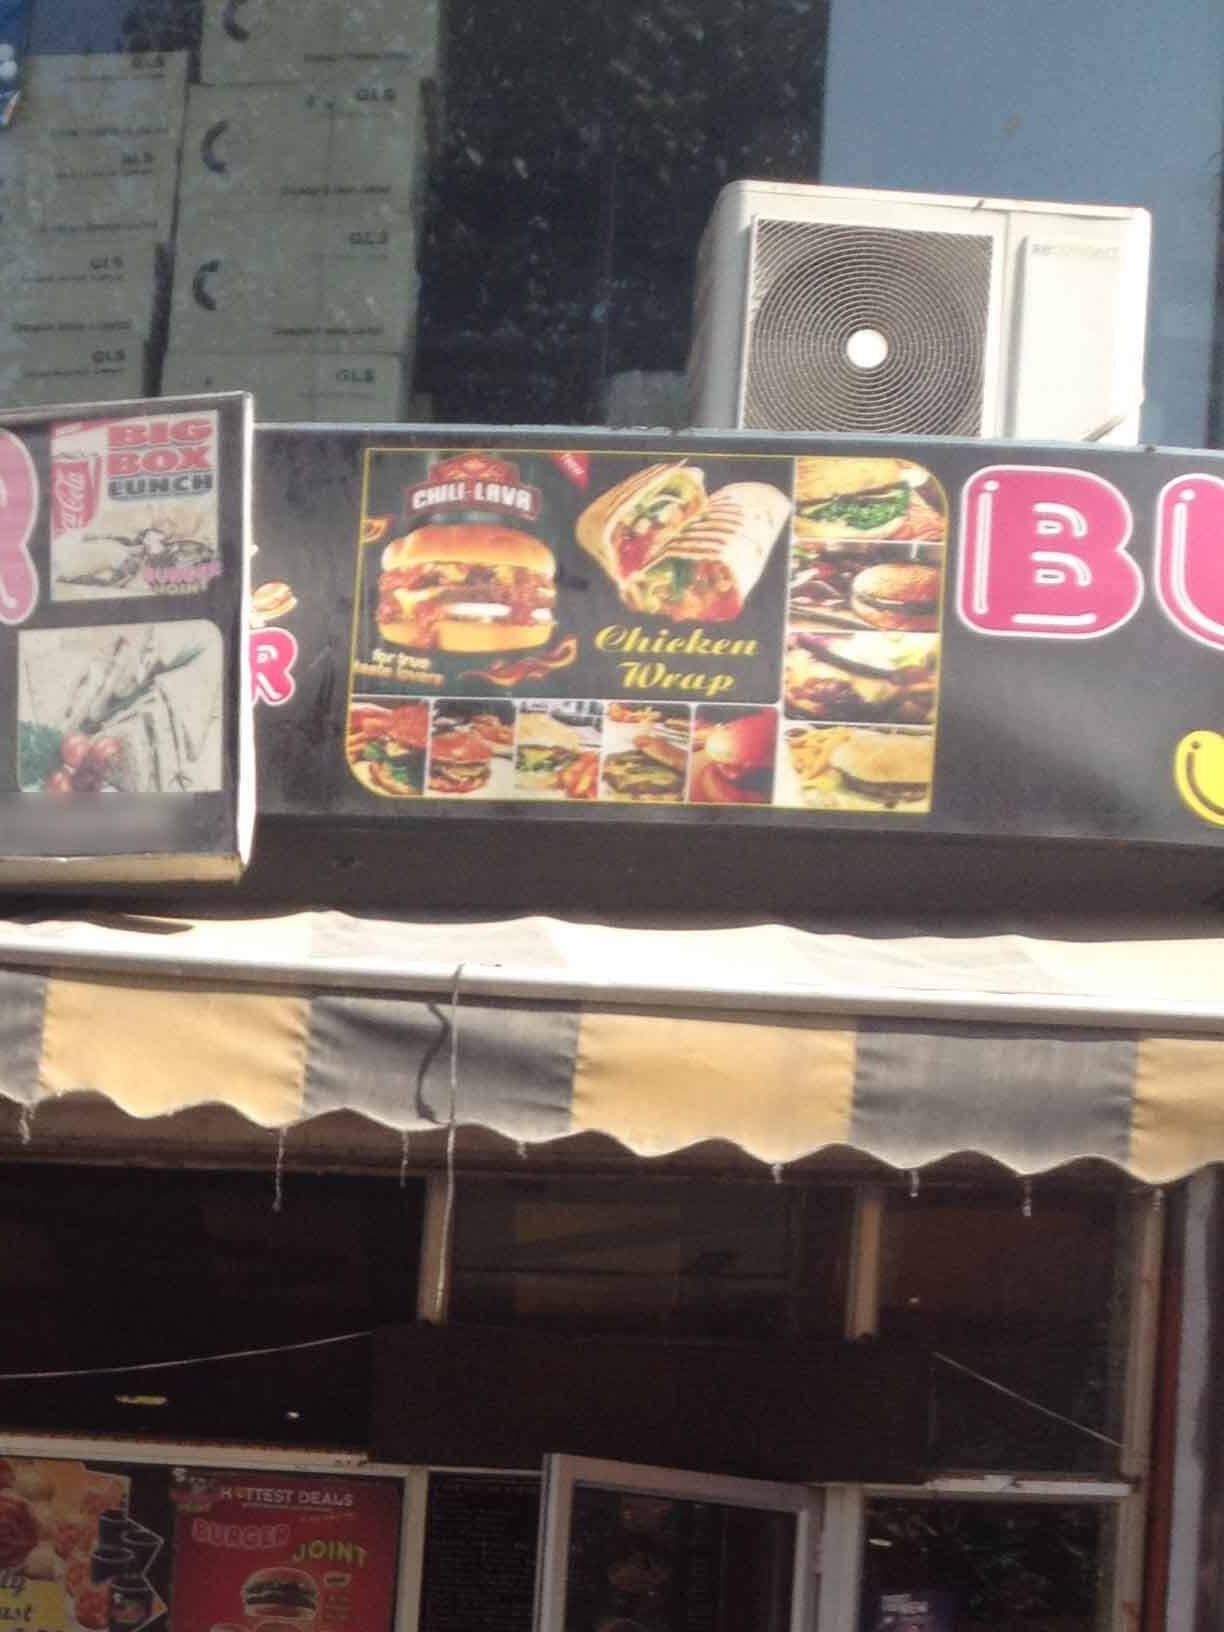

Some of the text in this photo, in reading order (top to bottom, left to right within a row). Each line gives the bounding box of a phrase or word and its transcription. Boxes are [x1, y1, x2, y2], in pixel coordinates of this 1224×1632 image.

[108, 419, 214, 449] BIG
[107, 447, 213, 478] BOX
[109, 473, 213, 500] LUNCH
[595, 623, 759, 658] Chicken
[618, 661, 735, 694] Wrap
